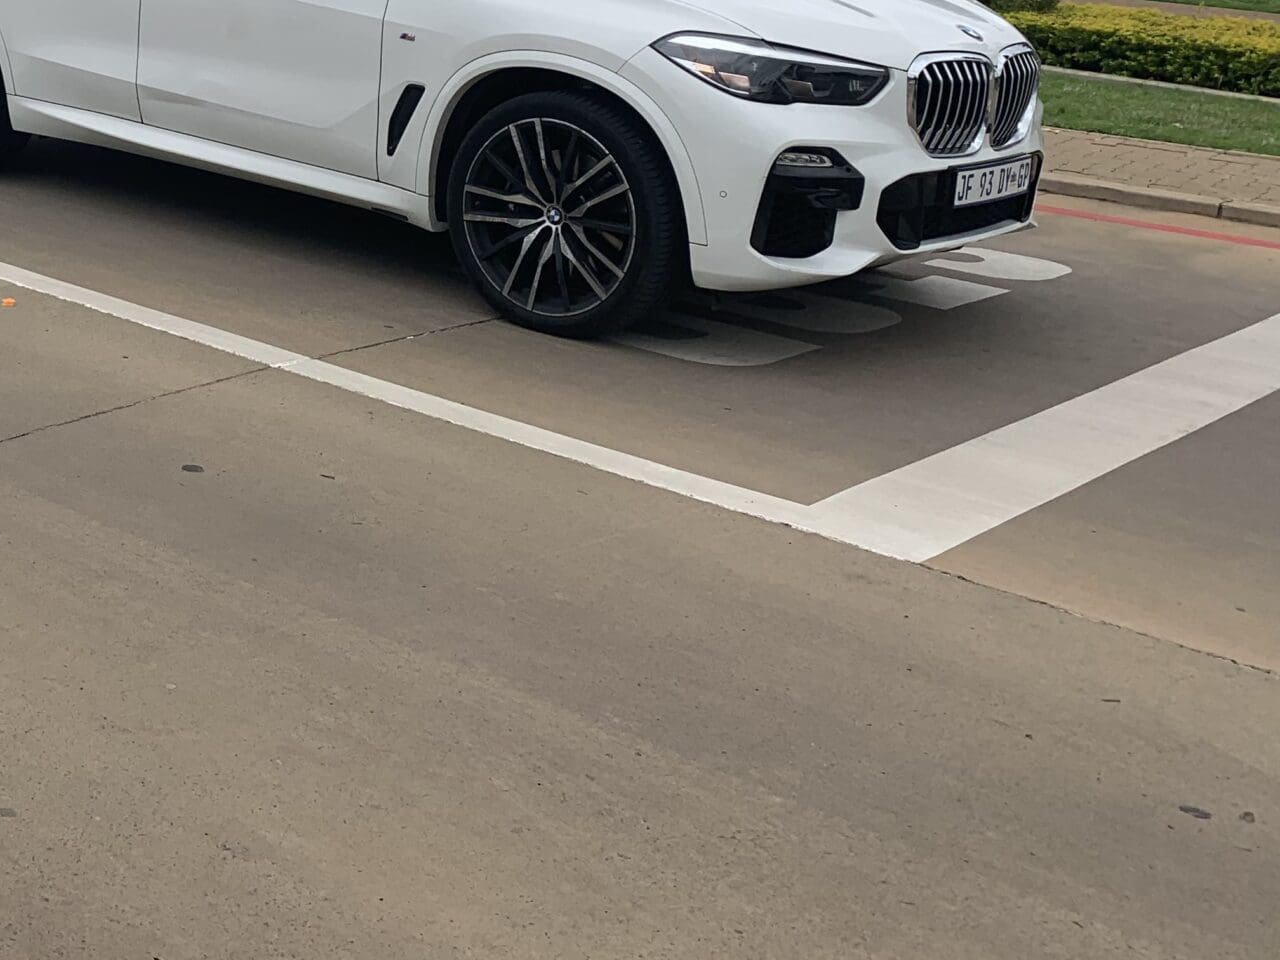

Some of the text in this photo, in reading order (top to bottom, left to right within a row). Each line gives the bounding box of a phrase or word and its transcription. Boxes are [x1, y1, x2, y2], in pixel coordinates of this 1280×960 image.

[957, 162, 1030, 201] JF 93 DY GP
